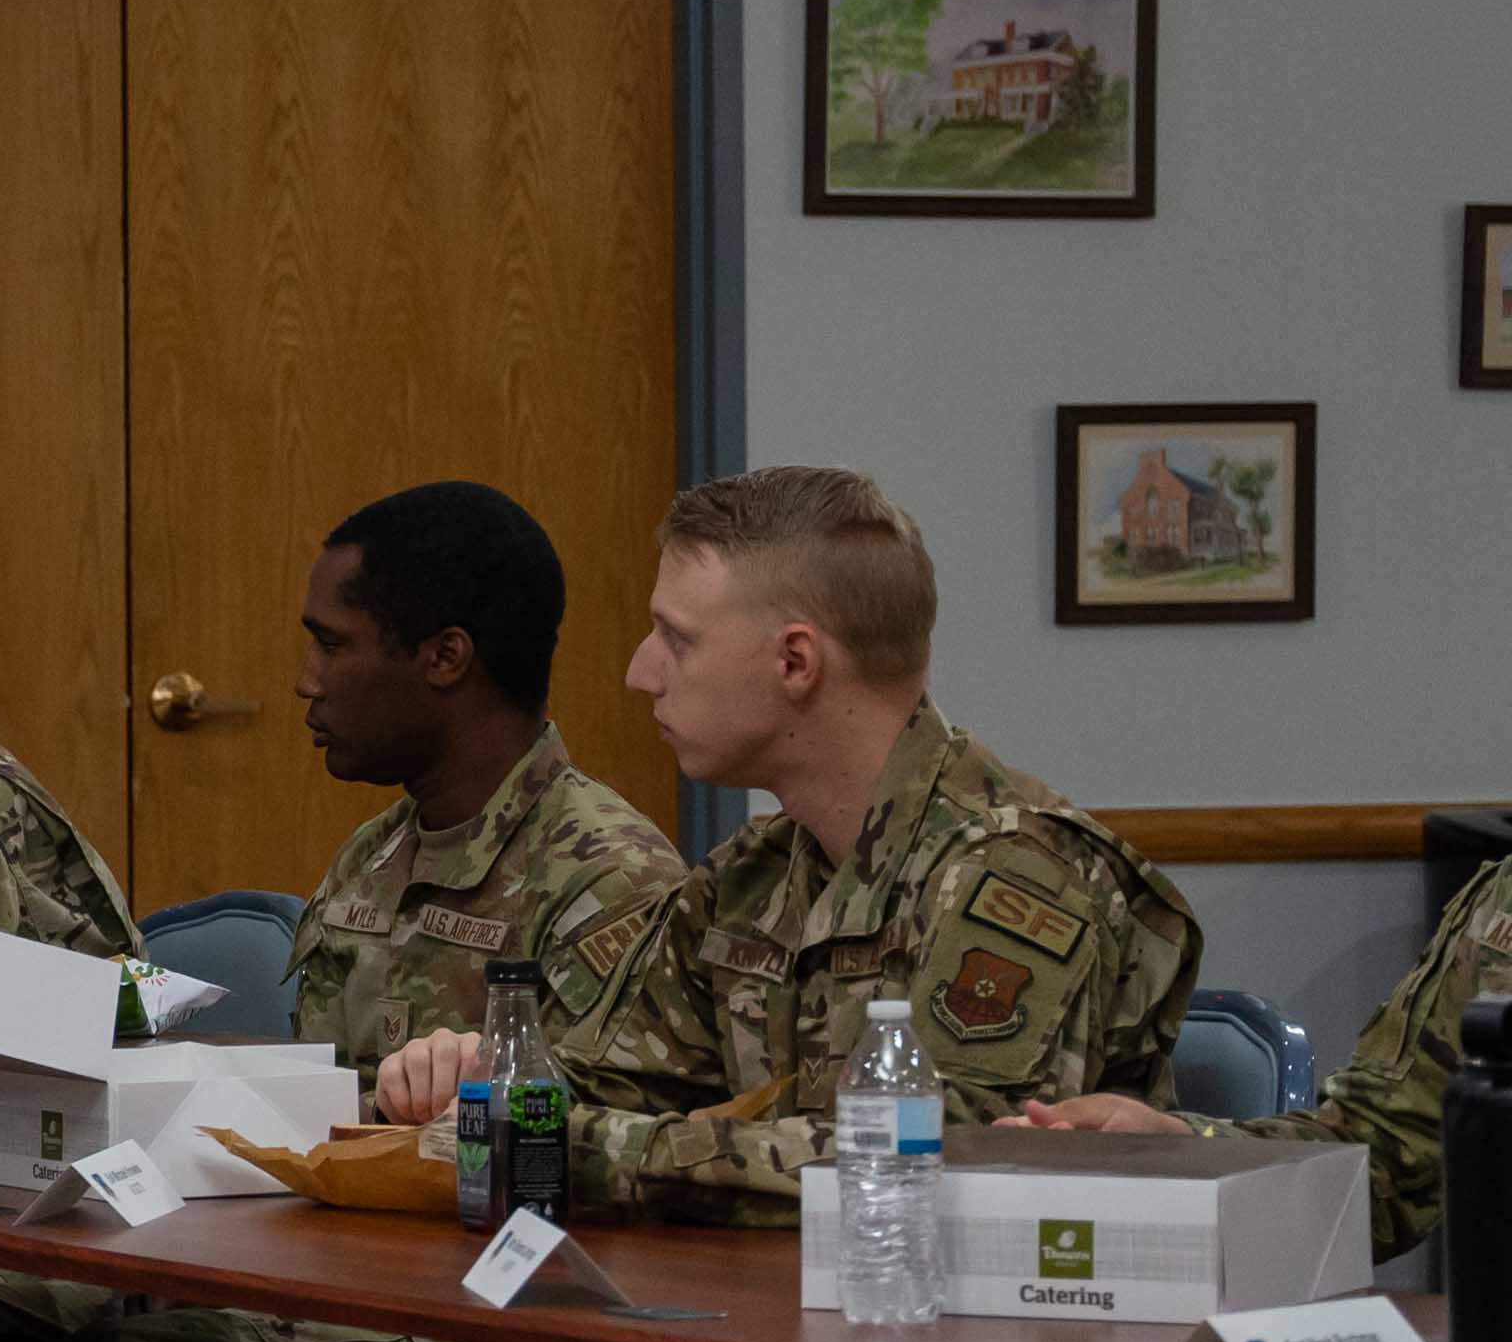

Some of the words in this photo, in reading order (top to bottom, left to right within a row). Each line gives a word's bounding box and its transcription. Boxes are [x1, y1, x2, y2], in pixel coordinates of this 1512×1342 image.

[983, 888, 1074, 940] SF
[423, 909, 449, 935] U.S.
[449, 916, 474, 942] AIR
[471, 920, 503, 947] FORCE
[460, 1102, 488, 1119] PURE
[460, 1119, 487, 1136] LEAF
[1019, 1284, 1115, 1310] Catering
